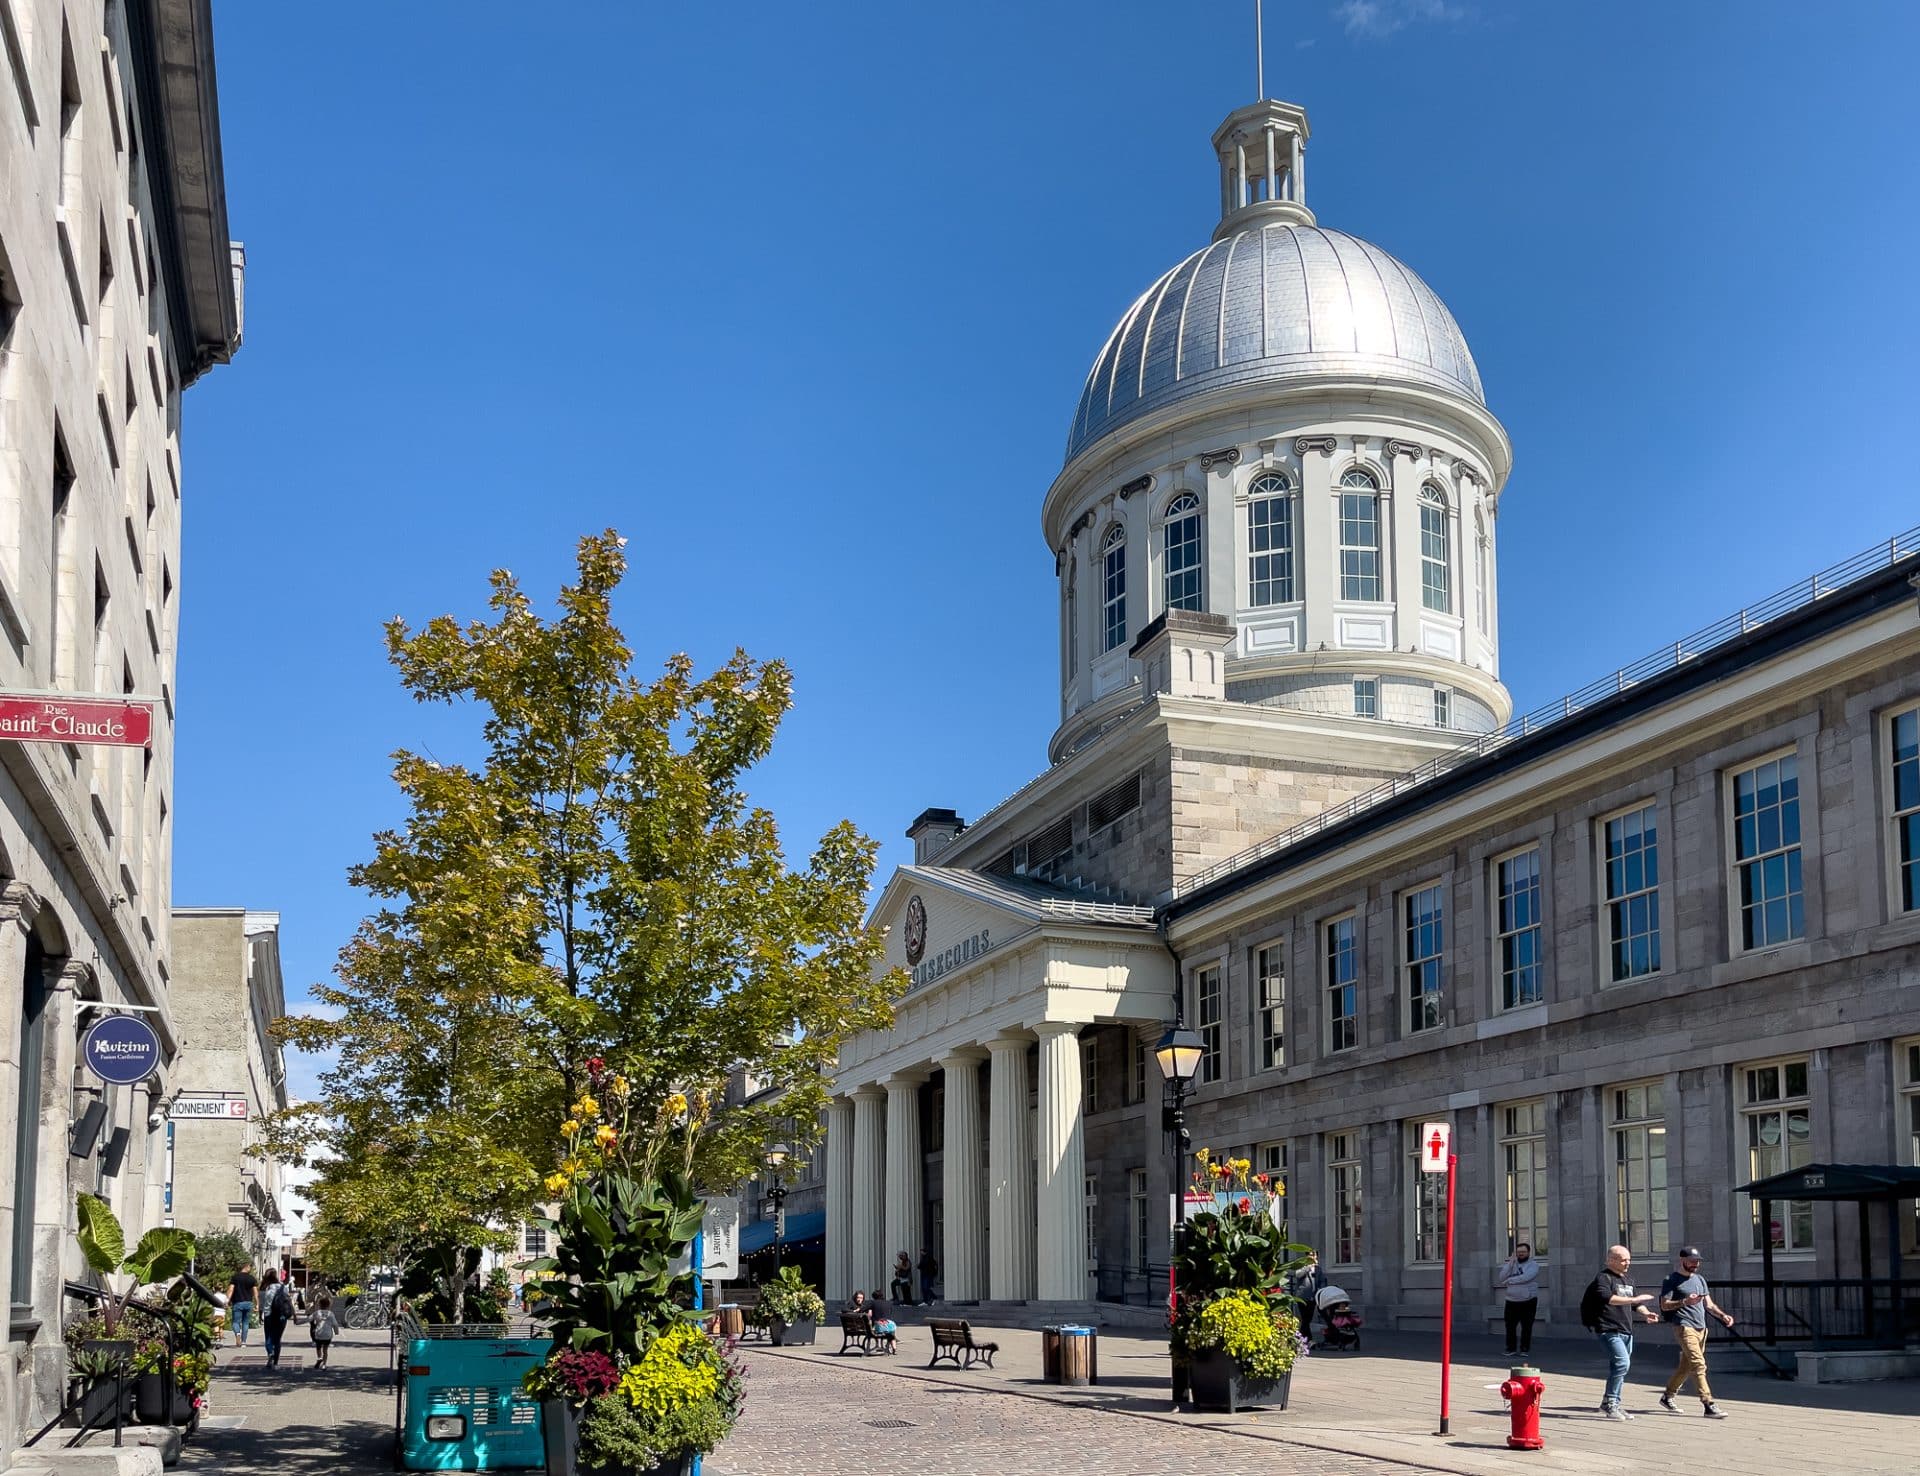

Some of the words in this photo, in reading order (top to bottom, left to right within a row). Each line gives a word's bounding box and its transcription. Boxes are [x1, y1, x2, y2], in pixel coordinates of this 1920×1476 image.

[44, 704, 68, 715] Rue
[0, 715, 125, 737] aint-Claude
[911, 929, 994, 988] ONSECOURS.
[94, 1040, 150, 1053] Kwizinn
